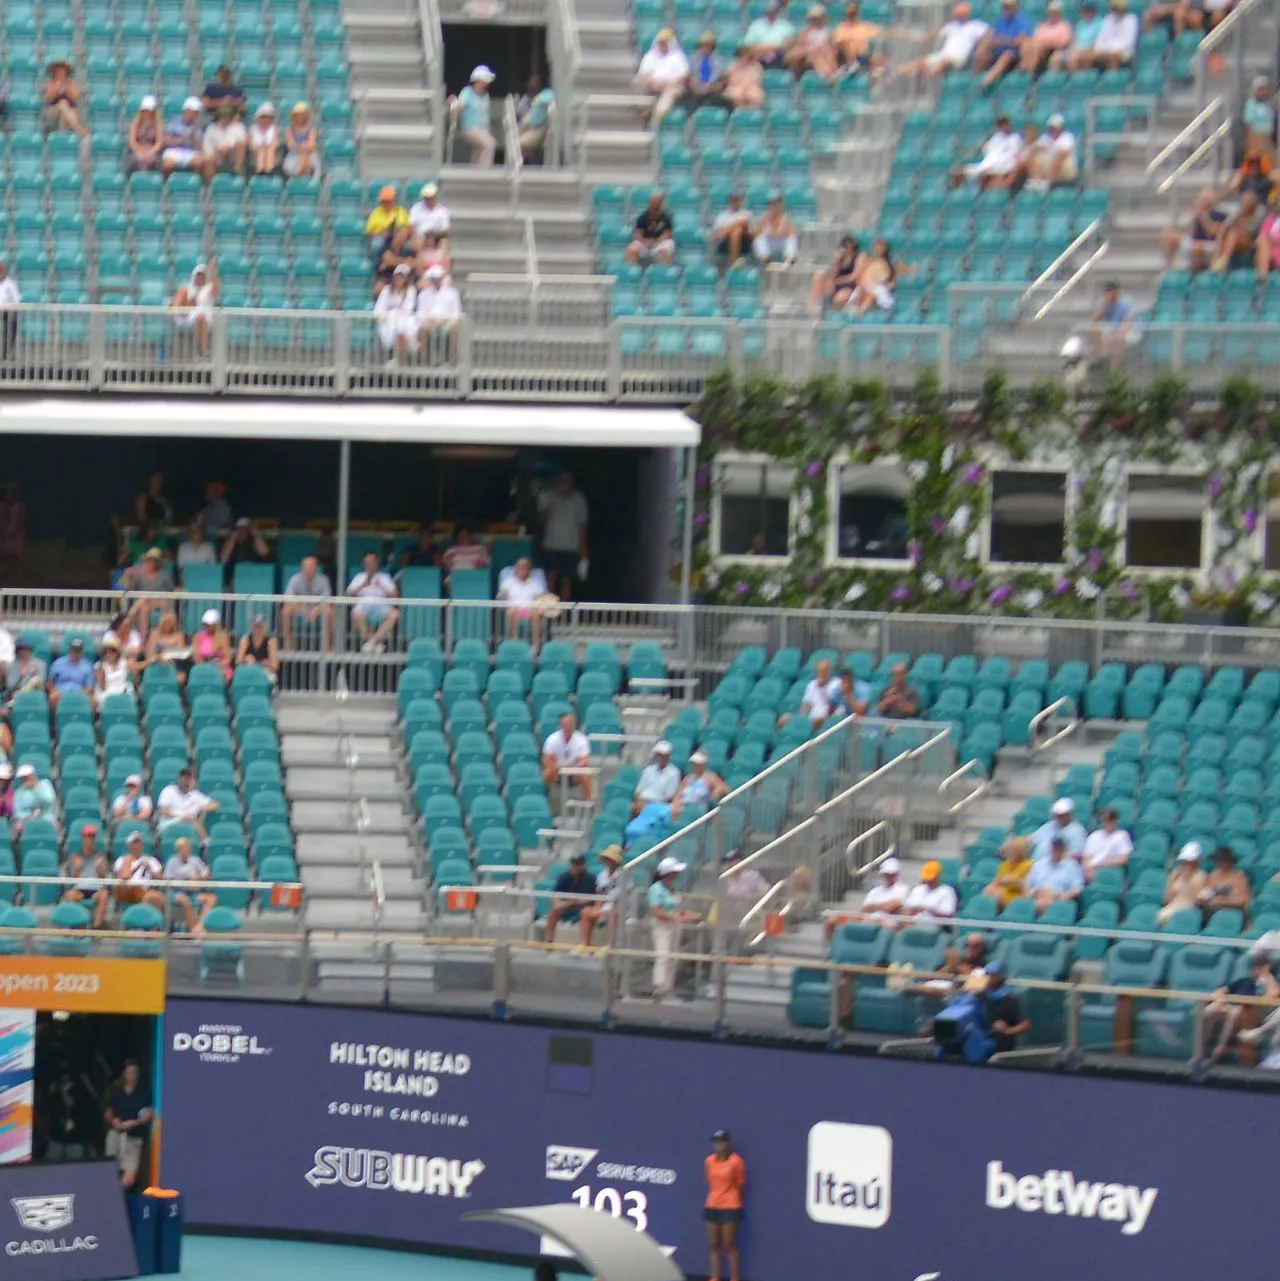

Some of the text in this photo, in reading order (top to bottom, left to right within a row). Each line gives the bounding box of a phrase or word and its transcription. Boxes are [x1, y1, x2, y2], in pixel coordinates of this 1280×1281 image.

[52, 973, 100, 993] 2023
[173, 1032, 264, 1055] DOBEL
[330, 1042, 471, 1076] HILTON HEAD
[364, 1070, 439, 1097] ISLAND
[328, 1100, 469, 1128] SOUTH CAROLINA
[305, 1145, 486, 1198] SUBWAY
[547, 1152, 677, 1186] SAP SERVE SPEED
[813, 1170, 883, 1211] Itaú
[986, 1160, 1159, 1236] betway
[5, 1235, 99, 1256] CADILLAC
